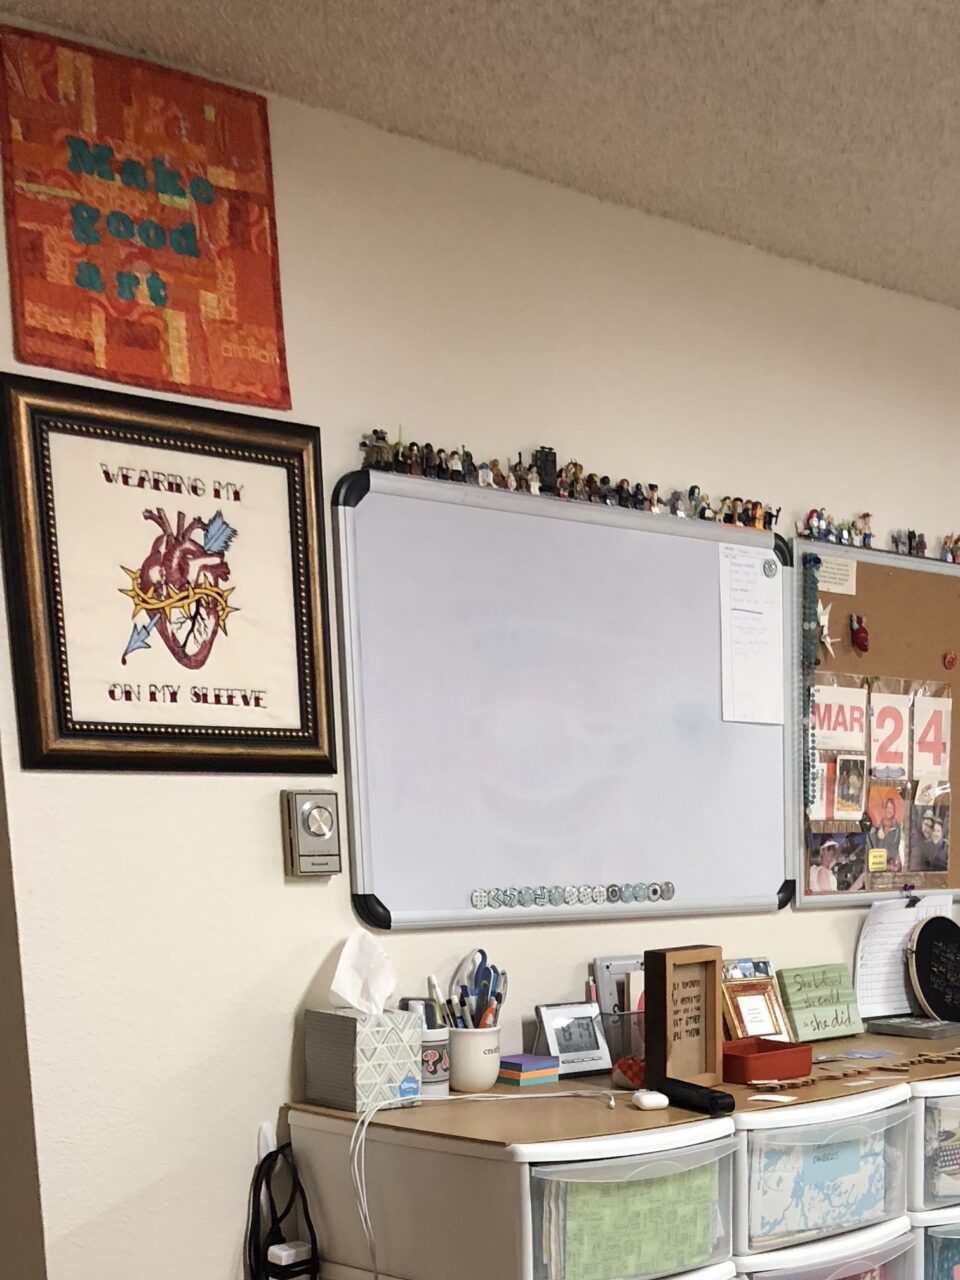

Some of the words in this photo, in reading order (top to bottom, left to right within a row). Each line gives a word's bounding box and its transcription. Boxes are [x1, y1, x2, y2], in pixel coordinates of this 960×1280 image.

[65, 135, 215, 205] Make
[71, 203, 201, 258] good
[75, 261, 168, 308] art
[99, 463, 206, 497] WEARING
[213, 480, 244, 502] MY
[108, 683, 141, 702] ON
[149, 684, 181, 703] MY
[190, 685, 268, 709] SLEEVE
[814, 703, 864, 733] MAR
[875, 705, 904, 764] 2
[917, 709, 946, 766] 4
